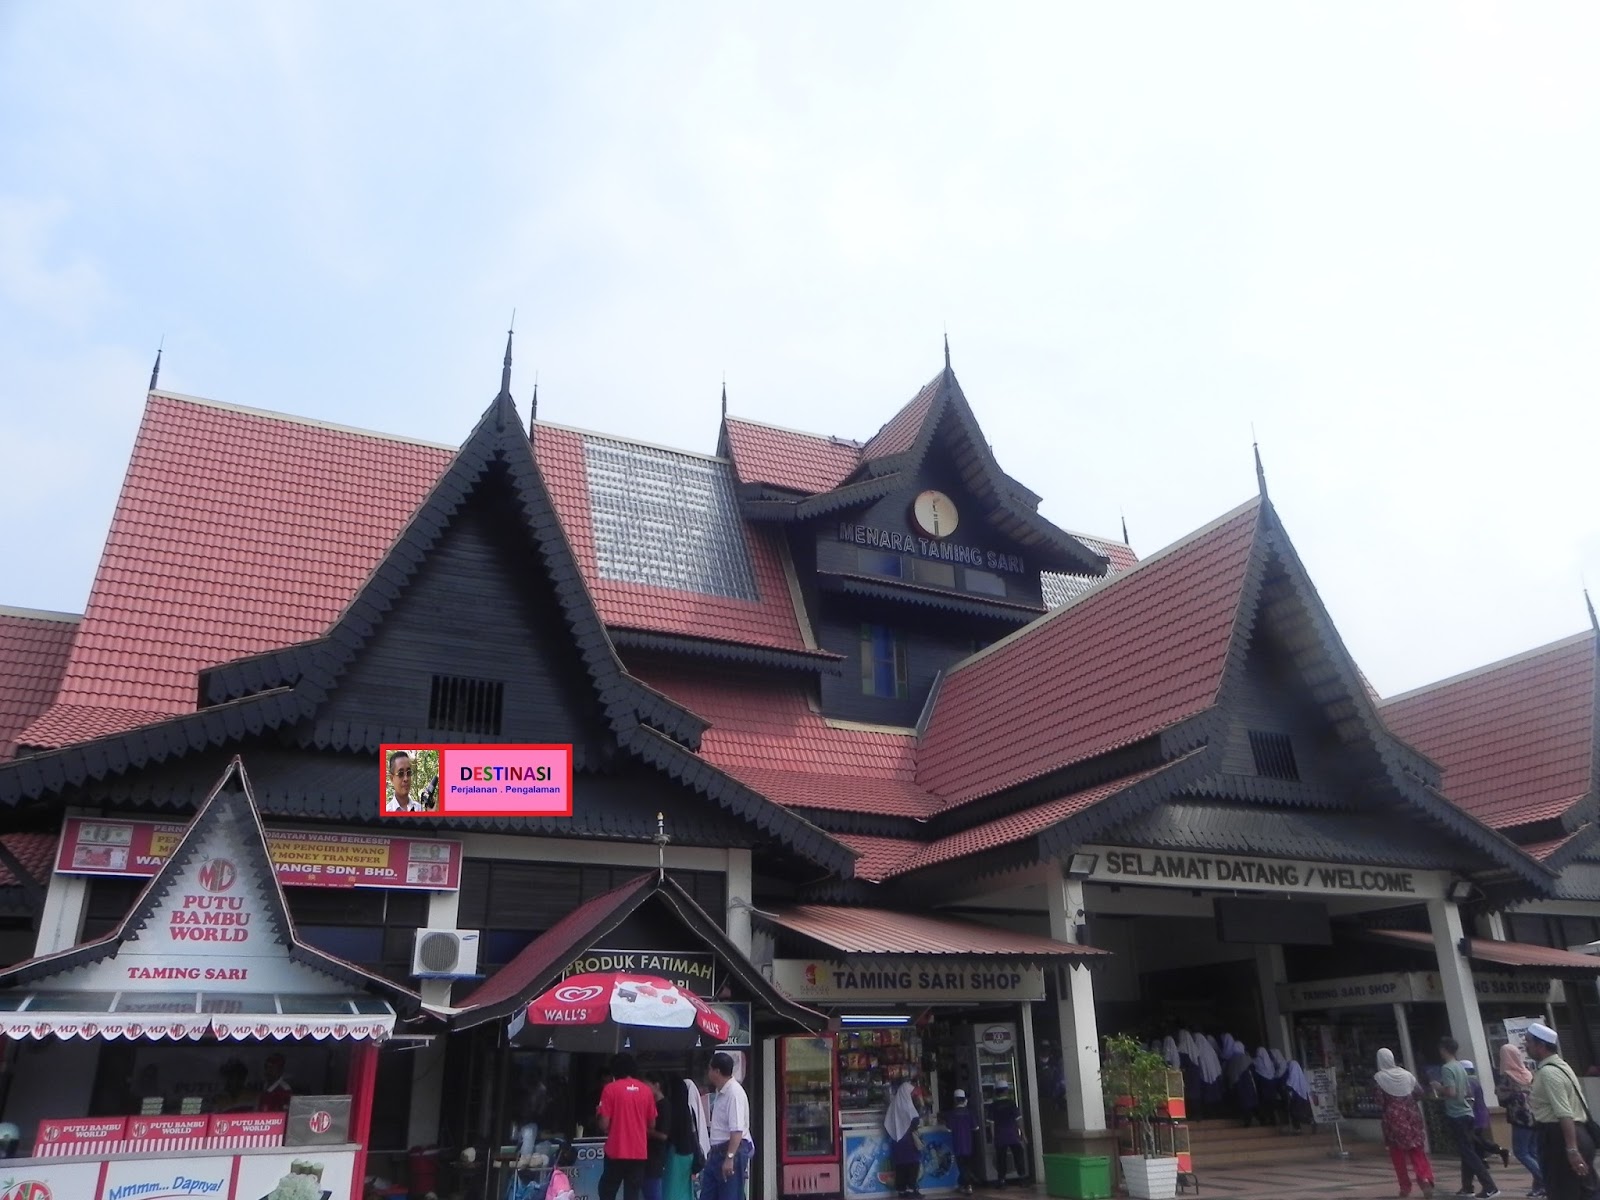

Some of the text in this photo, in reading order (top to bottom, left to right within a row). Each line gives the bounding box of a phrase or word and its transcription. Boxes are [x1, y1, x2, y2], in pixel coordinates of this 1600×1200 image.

[839, 522, 1025, 574] MENARA TAMING SARI
[308, 834, 339, 842] WANG
[341, 836, 391, 845] BERLESEN
[293, 844, 349, 853] PENGIRIM
[351, 847, 385, 855] WANG
[278, 852, 321, 860] MONEY
[322, 854, 381, 864] TRANSFER
[326, 865, 360, 875] SDN.
[364, 867, 398, 877] BHD.
[1106, 852, 1212, 880] SELAMAT
[1216, 859, 1299, 887] DATANG
[1320, 868, 1415, 893] WELCOME
[182, 895, 245, 910] PUTU
[170, 910, 251, 926] BAMBU
[169, 926, 249, 942] WORLD
[127, 967, 248, 980] TAMING SARI
[565, 954, 713, 980] PRODUK FATIMAH
[832, 972, 1021, 990] TAMING SARI SHOP
[1491, 981, 1520, 994] SARI
[1522, 981, 1551, 993] SHOP
[1341, 986, 1366, 997] SARI
[1368, 983, 1397, 996] SHOP
[544, 1008, 587, 1021] WALL'S
[103, 1025, 123, 1033] MD
[148, 1025, 166, 1033] MD
[352, 1026, 369, 1034] MD
[109, 1176, 224, 1200] Mmmm... Dapnya!
